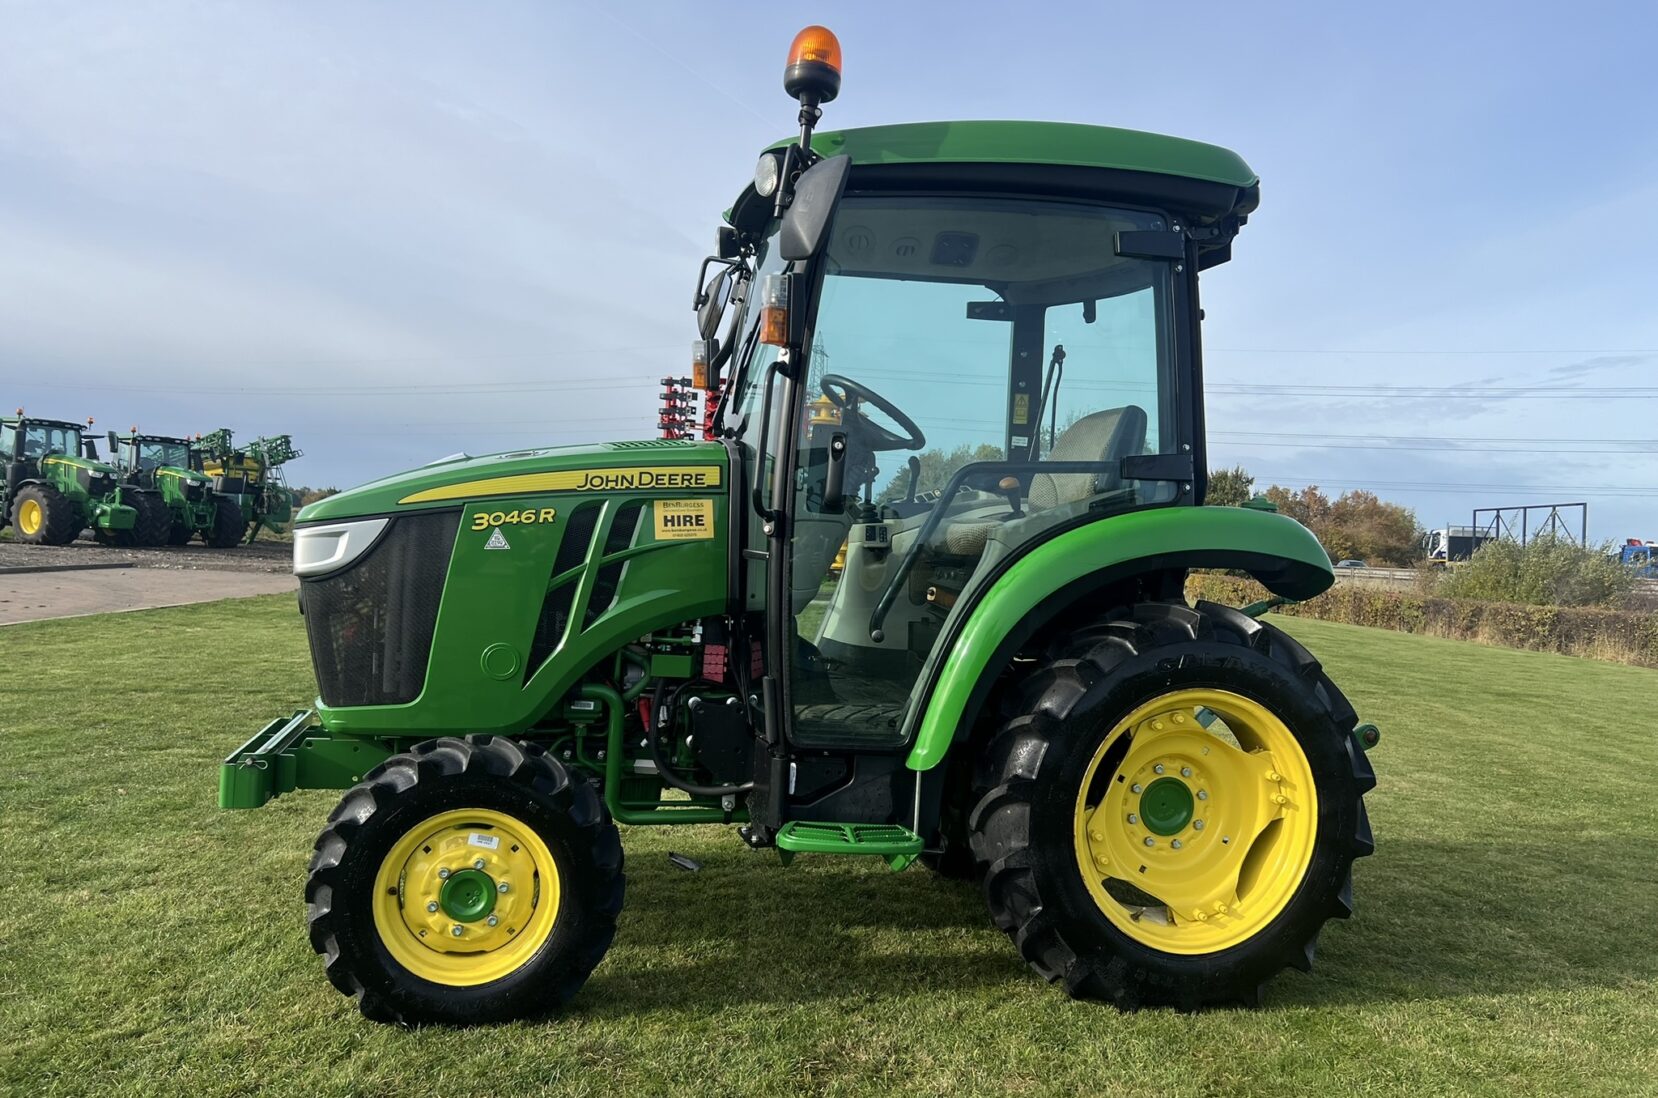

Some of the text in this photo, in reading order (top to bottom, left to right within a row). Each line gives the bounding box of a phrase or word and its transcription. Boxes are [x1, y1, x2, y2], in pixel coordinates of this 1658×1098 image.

[576, 471, 706, 489] JOHN DEERE
[663, 514, 705, 527] HIRE
